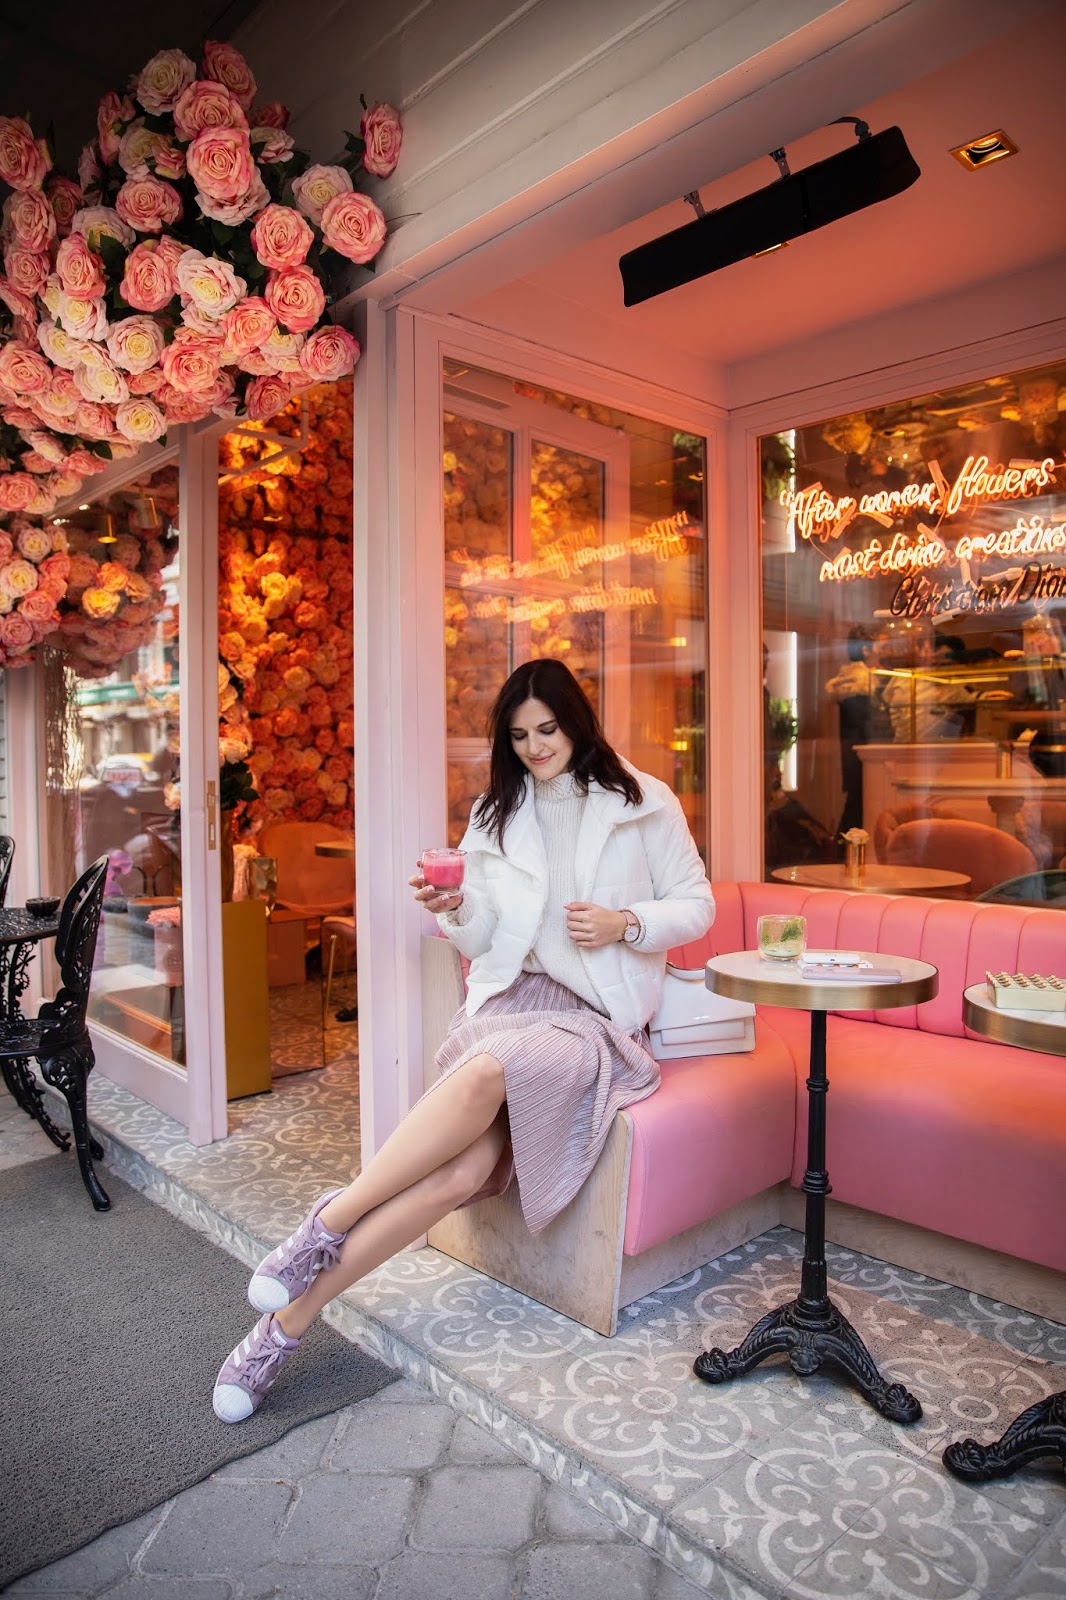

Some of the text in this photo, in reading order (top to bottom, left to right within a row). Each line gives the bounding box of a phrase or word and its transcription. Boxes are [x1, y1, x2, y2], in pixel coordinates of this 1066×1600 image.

[860, 483, 941, 514] women,
[947, 456, 1054, 514] flowers
[820, 538, 882, 582] most
[879, 532, 946, 570] divine
[890, 576, 1010, 618] Christian
